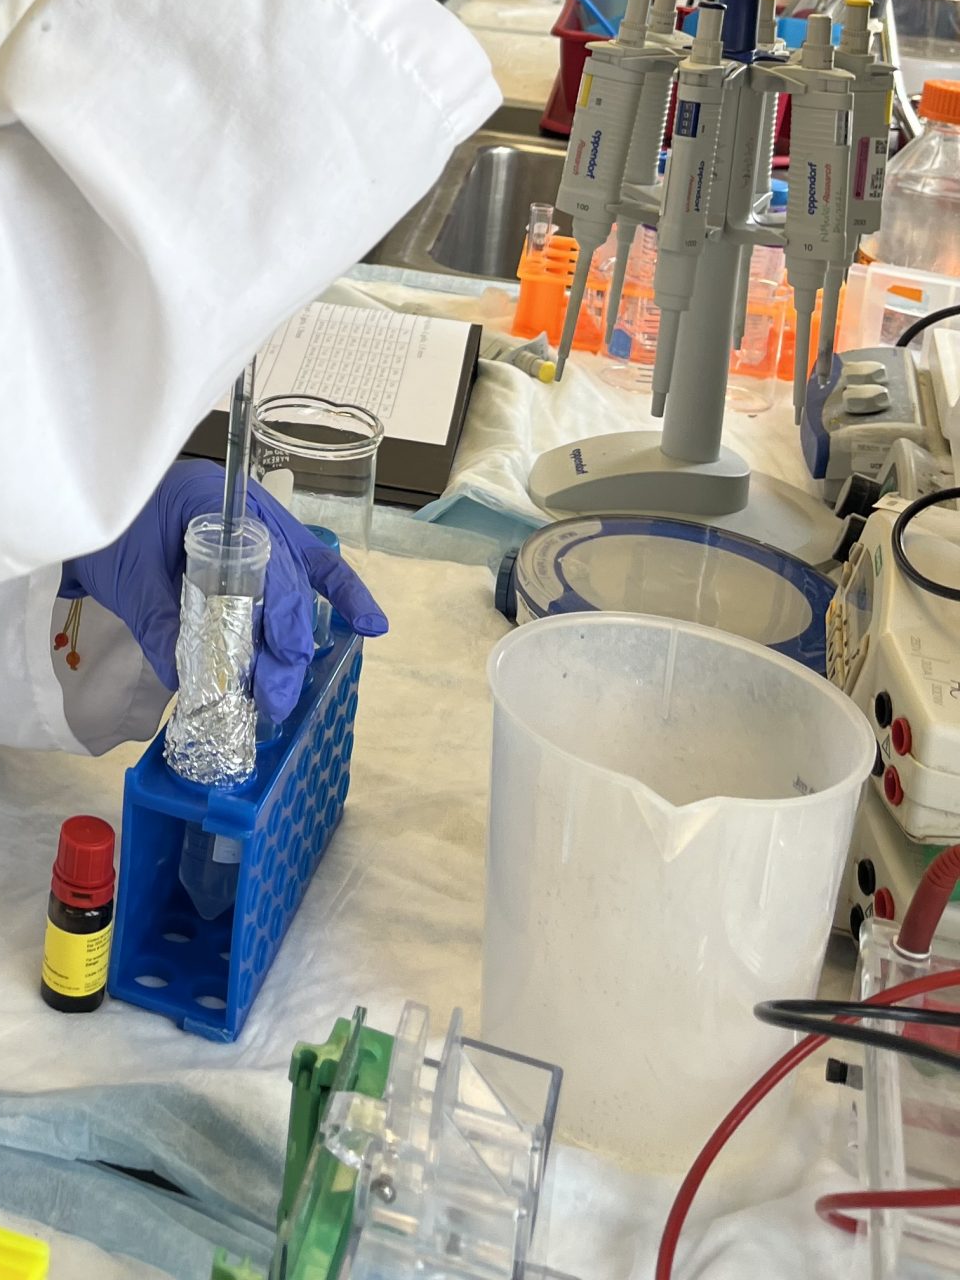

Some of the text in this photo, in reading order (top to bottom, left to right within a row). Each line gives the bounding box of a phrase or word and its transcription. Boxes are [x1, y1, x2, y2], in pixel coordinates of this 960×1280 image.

[587, 130, 602, 180] eppendorf
[576, 202, 589, 212] 100
[694, 160, 705, 212] eppendorf
[808, 161, 818, 215] eppendorf
[803, 243, 813, 252] 10
